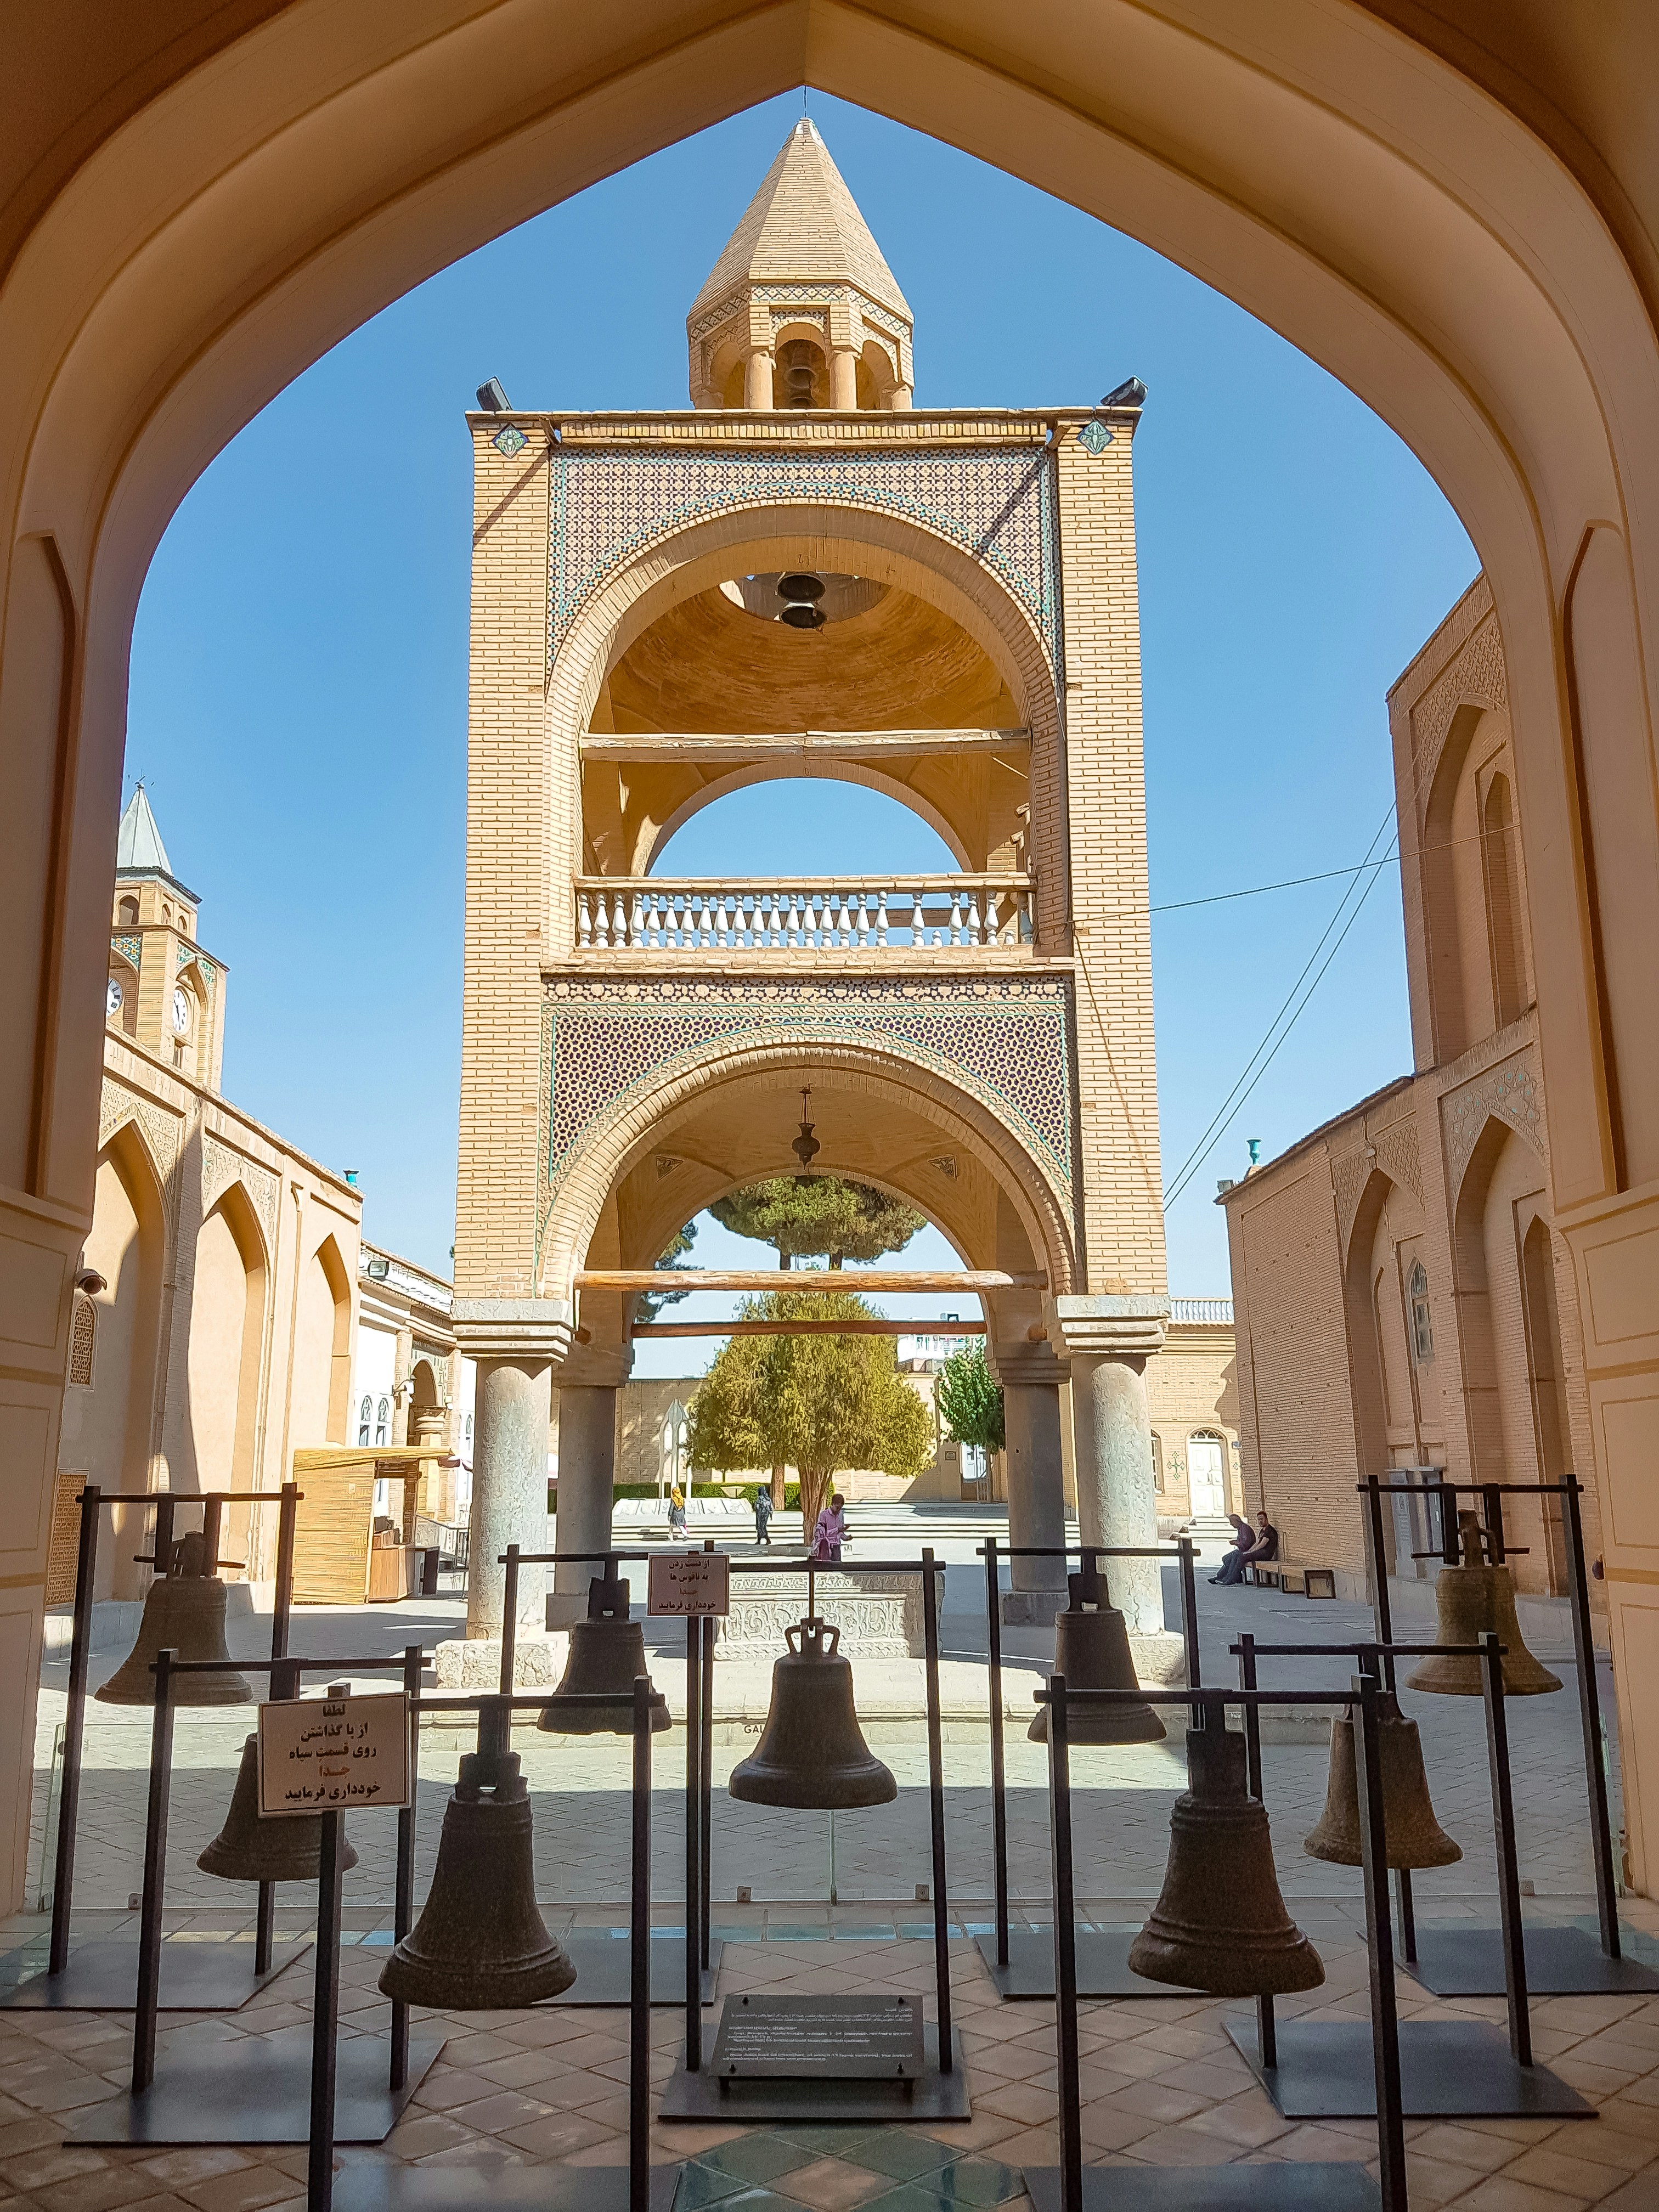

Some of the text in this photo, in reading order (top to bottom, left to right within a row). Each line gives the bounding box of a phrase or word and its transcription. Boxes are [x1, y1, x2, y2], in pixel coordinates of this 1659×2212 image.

[703, 1559, 710, 1569] از
[357, 1722, 368, 1738] از
[290, 1746, 313, 1762] سیاه
[352, 1746, 377, 1758] روی
[329, 1781, 381, 1800] خودداری
